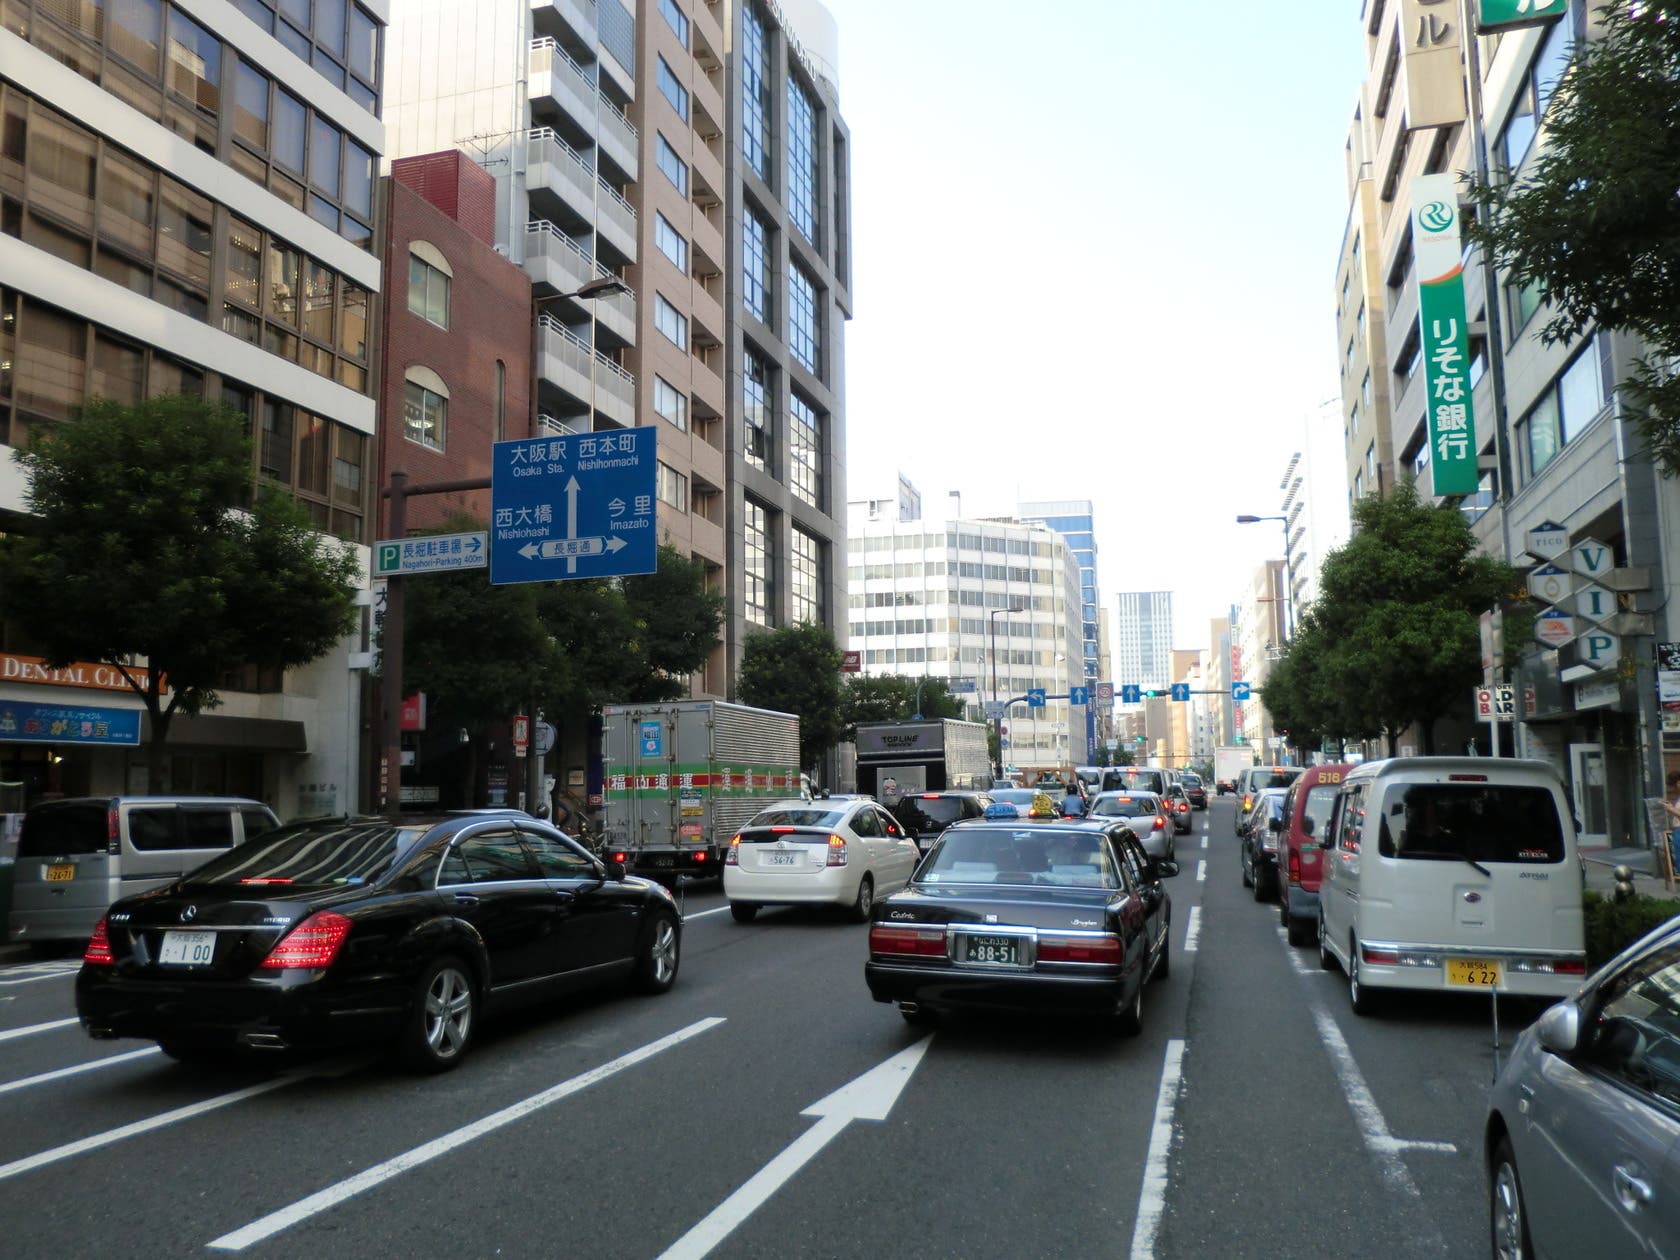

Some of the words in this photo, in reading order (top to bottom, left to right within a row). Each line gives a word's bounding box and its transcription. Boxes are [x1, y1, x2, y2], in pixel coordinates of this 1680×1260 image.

[1416, 0, 1449, 47] ル
[1432, 318, 1468, 461] りそな銀行
[511, 441, 567, 464] 大阪駅
[579, 434, 637, 458] 西本町
[513, 466, 542, 477] Osaka
[547, 463, 565, 474] Sta.
[578, 455, 639, 471] Nishihonmachi
[496, 504, 552, 527] 西大橋
[608, 495, 651, 517] 今里
[498, 527, 550, 540] Nishiohashi
[610, 518, 649, 530] Imazato
[384, 547, 397, 569] P
[404, 539, 462, 559] 長堀駐車場
[554, 541, 591, 555] 長堀通
[403, 557, 461, 570] Nagahori-Parking
[464, 554, 483, 563] 400m
[4, 657, 89, 683] DENTAL
[1479, 690, 1513, 702] OD
[612, 773, 693, 791] 福山通運
[977, 946, 1015, 962] 88-51
